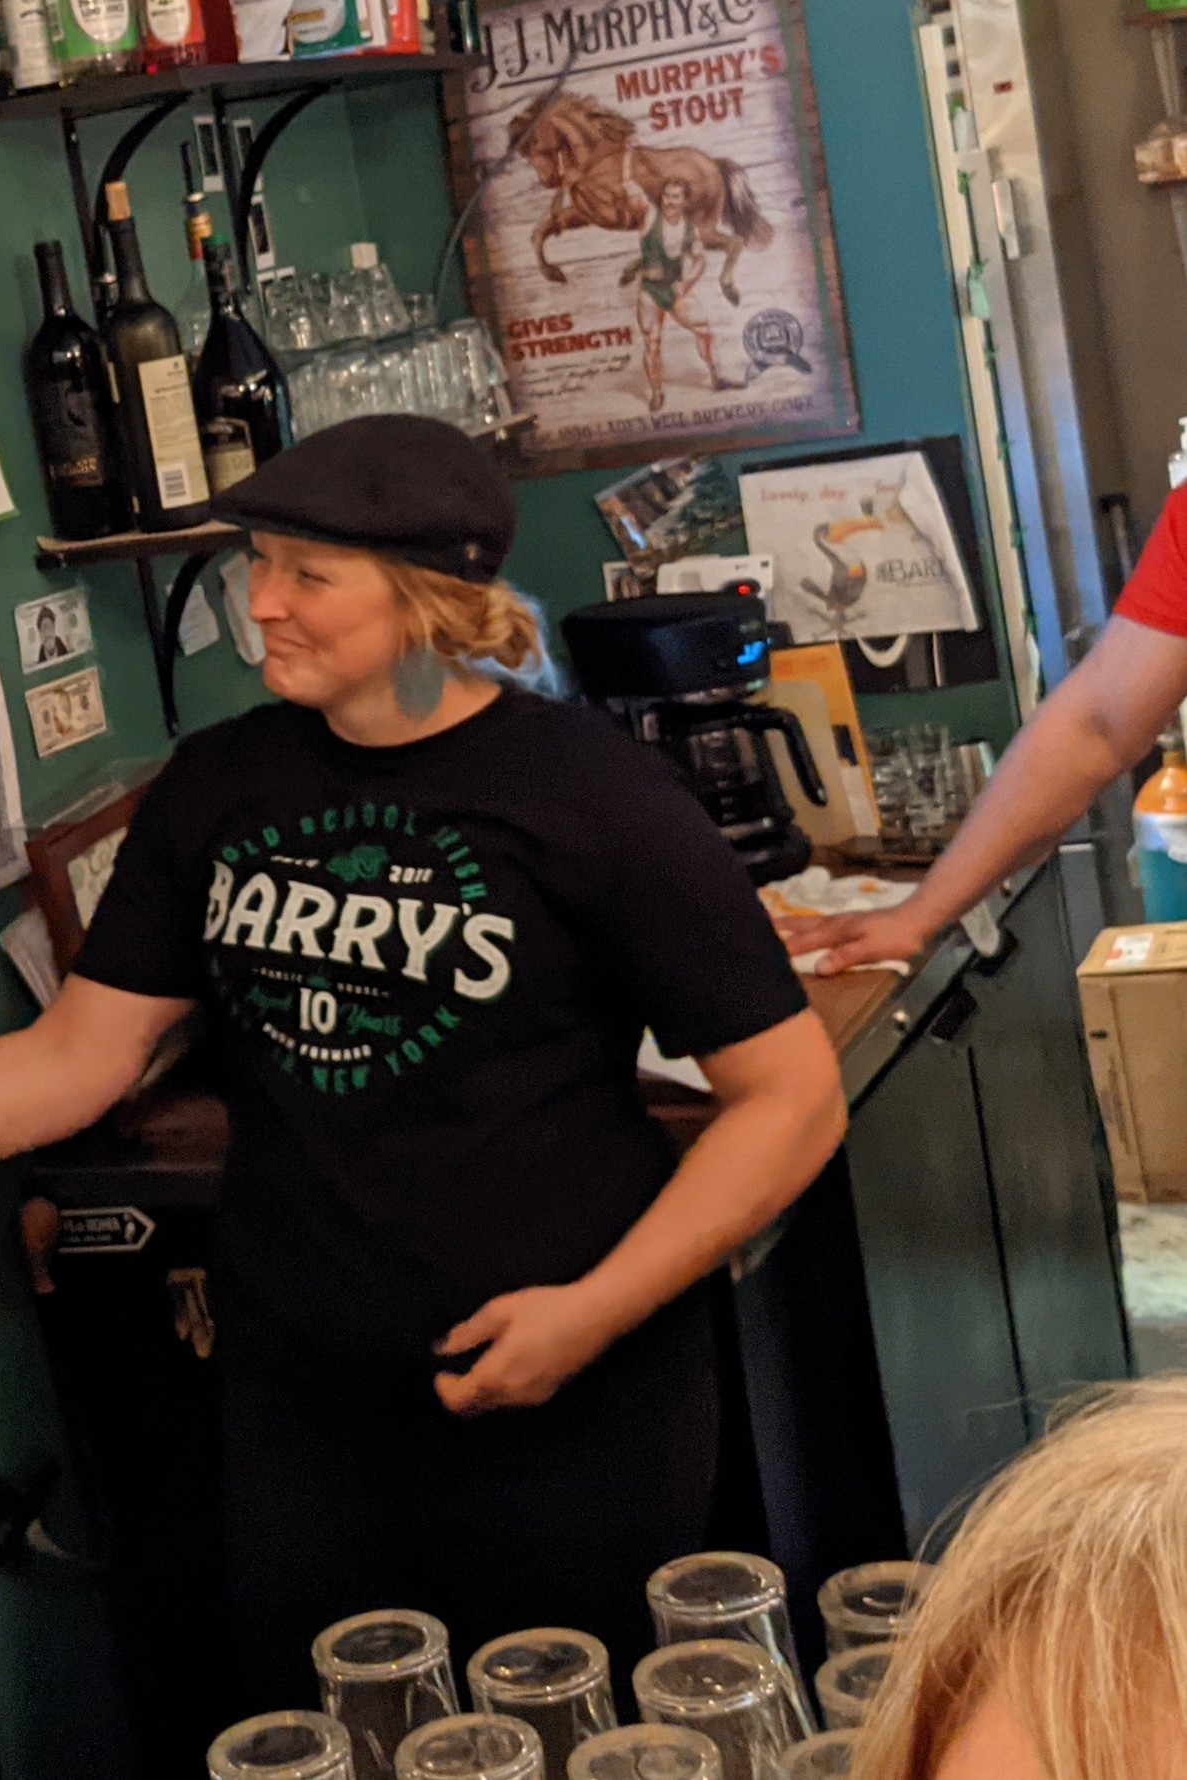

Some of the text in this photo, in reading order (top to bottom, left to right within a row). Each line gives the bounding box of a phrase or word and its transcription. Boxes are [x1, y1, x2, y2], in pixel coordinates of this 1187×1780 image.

[616, 45, 783, 103] MURPHY'S
[648, 87, 744, 133] STOUT
[508, 313, 574, 340] GIVES
[508, 326, 634, 362] STRENGTH
[388, 865, 434, 884] 2011
[202, 860, 515, 1001] BARRY'S
[299, 986, 338, 1035] 10
